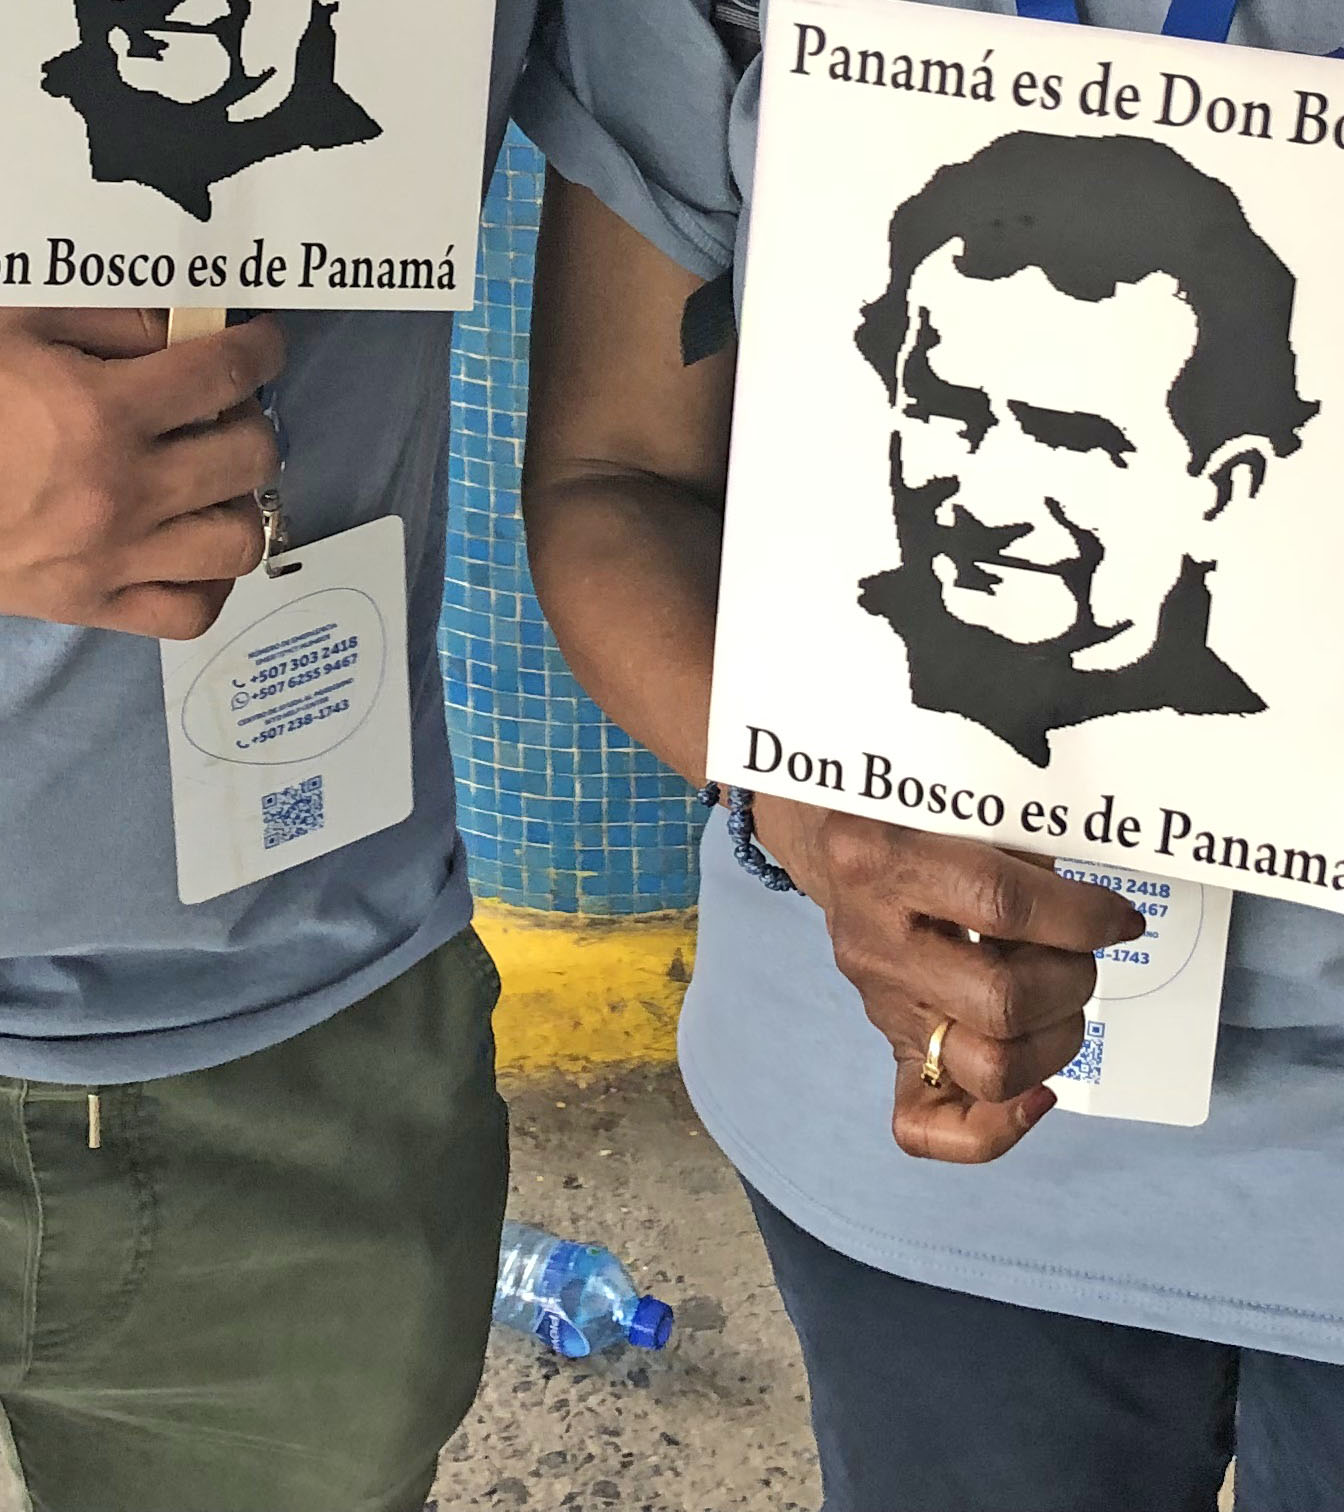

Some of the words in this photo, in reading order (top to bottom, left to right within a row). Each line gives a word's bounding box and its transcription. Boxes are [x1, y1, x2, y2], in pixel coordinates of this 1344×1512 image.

[790, 22, 996, 103] Panamá
[1012, 68, 1063, 111] es
[1079, 62, 1140, 120] de
[1153, 72, 1273, 140] Don
[42, 236, 175, 288] Bosco
[186, 253, 227, 289] es
[239, 238, 287, 289] de
[297, 242, 457, 291] Panamá
[250, 662, 288, 683] +507
[290, 651, 319, 671] 303
[321, 636, 358, 659] 2418
[251, 681, 285, 700] +507
[251, 724, 285, 744] +507
[742, 725, 845, 792] Don
[858, 752, 1005, 827] Bosco
[1020, 801, 1069, 837] es
[1084, 795, 1142, 848] de
[1126, 878, 1171, 898] 2418
[1095, 948, 1150, 965] 8-1743
